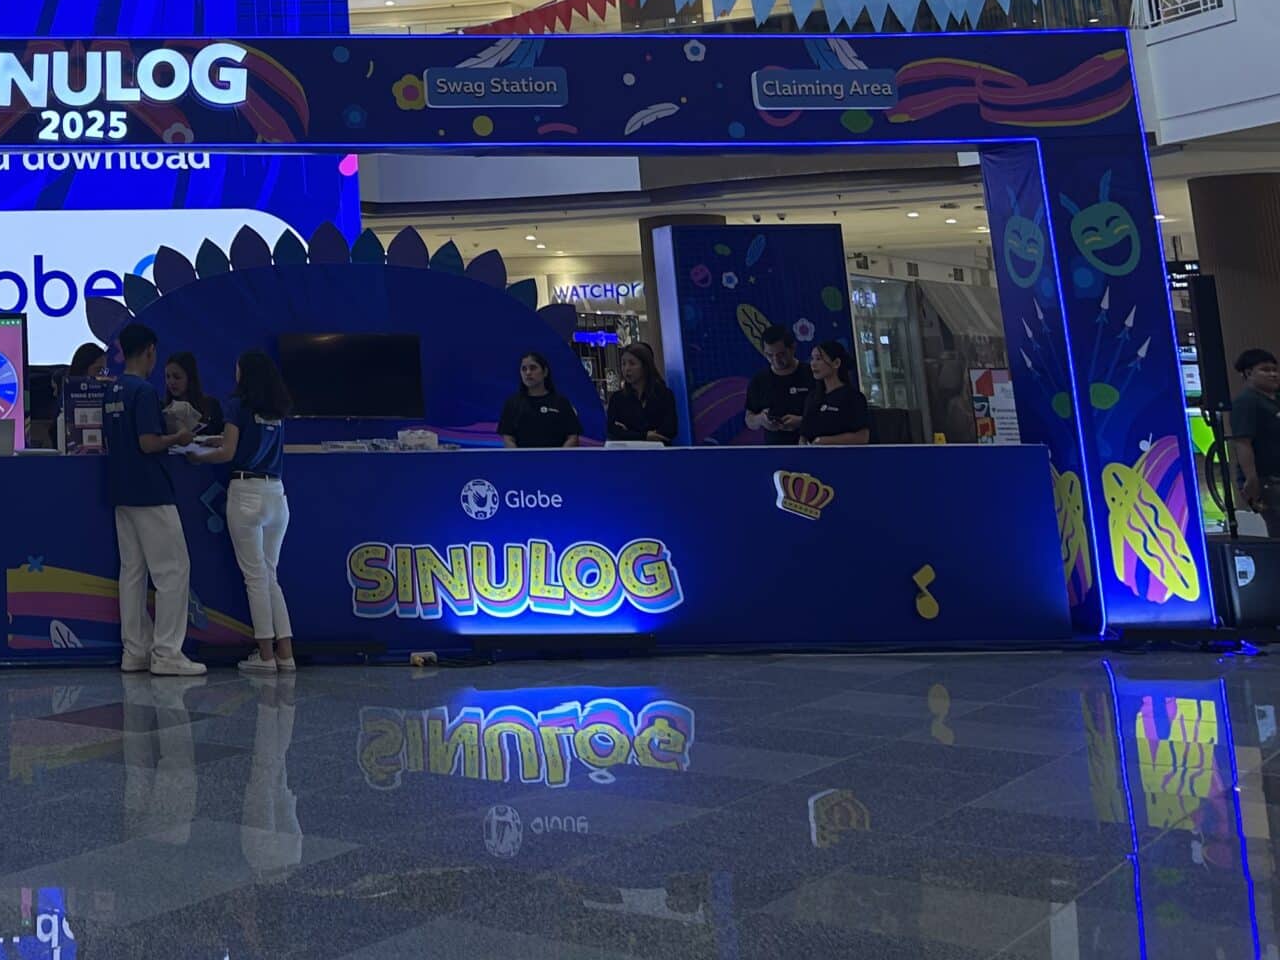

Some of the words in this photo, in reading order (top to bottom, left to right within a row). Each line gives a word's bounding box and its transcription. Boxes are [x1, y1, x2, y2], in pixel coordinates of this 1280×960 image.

[435, 76, 486, 97] Swag
[489, 76, 559, 95] Station
[762, 78, 845, 101] Claiming
[848, 79, 893, 97] Area
[38, 110, 128, 141] 2025
[22, 150, 212, 172] download
[504, 488, 563, 510] Globe
[346, 537, 685, 619] SINULOG
